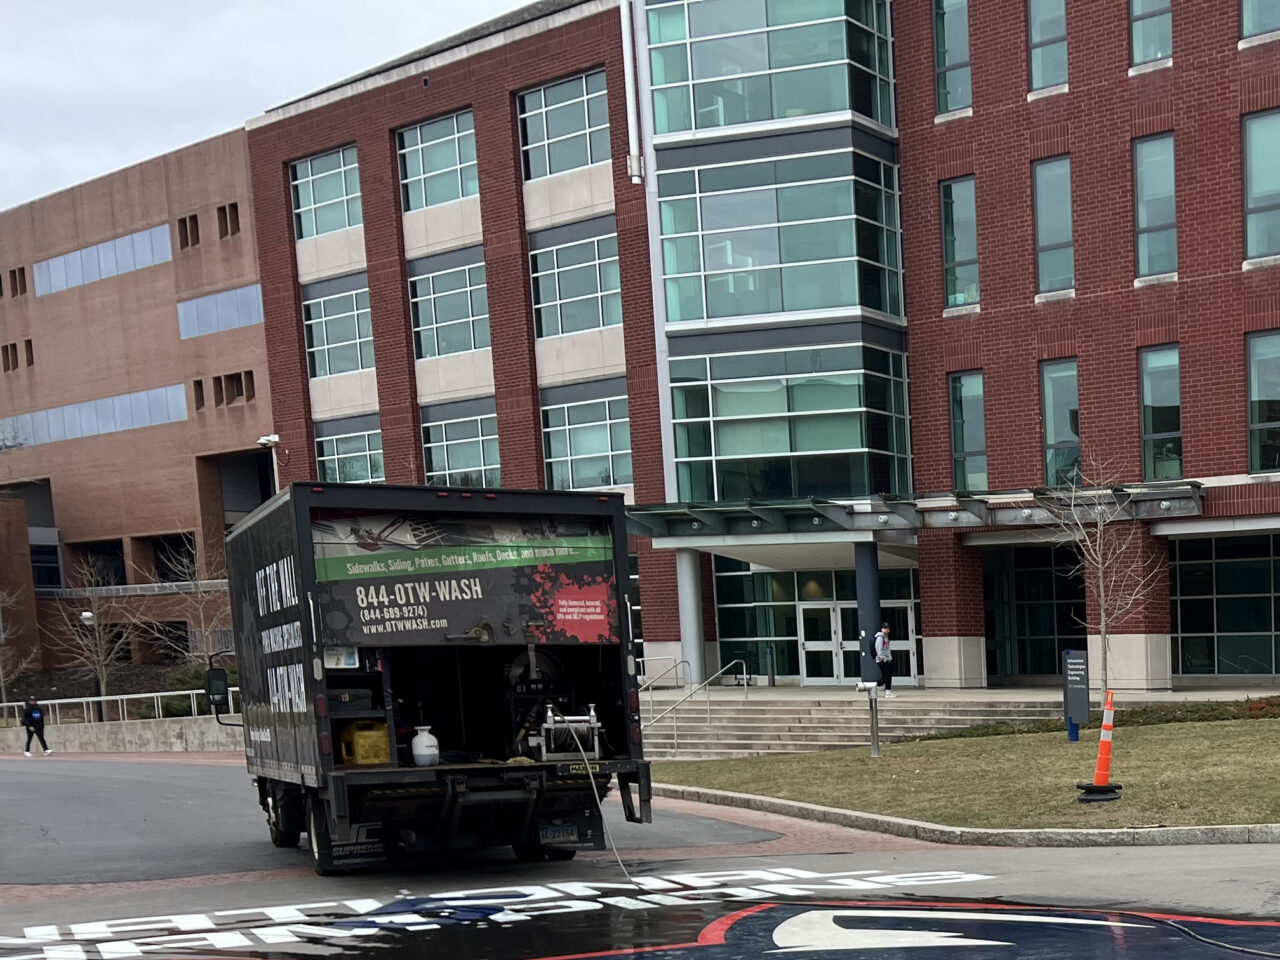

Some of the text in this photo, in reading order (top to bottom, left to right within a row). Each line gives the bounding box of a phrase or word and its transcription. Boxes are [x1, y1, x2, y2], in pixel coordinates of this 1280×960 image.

[347, 561, 388, 574] Sidewalks,
[388, 559, 414, 571] Siding,
[415, 557, 441, 569] Patios,
[442, 553, 472, 565] Gutters,
[473, 551, 496, 562] Roofs,
[496, 549, 520, 560] Decks,
[521, 548, 534, 559] and
[535, 547, 554, 557] much
[356, 578, 483, 607] 844-OTW-WASH
[360, 605, 427, 622] (844-689-9274)
[362, 619, 448, 634] www.OTWWASH.com
